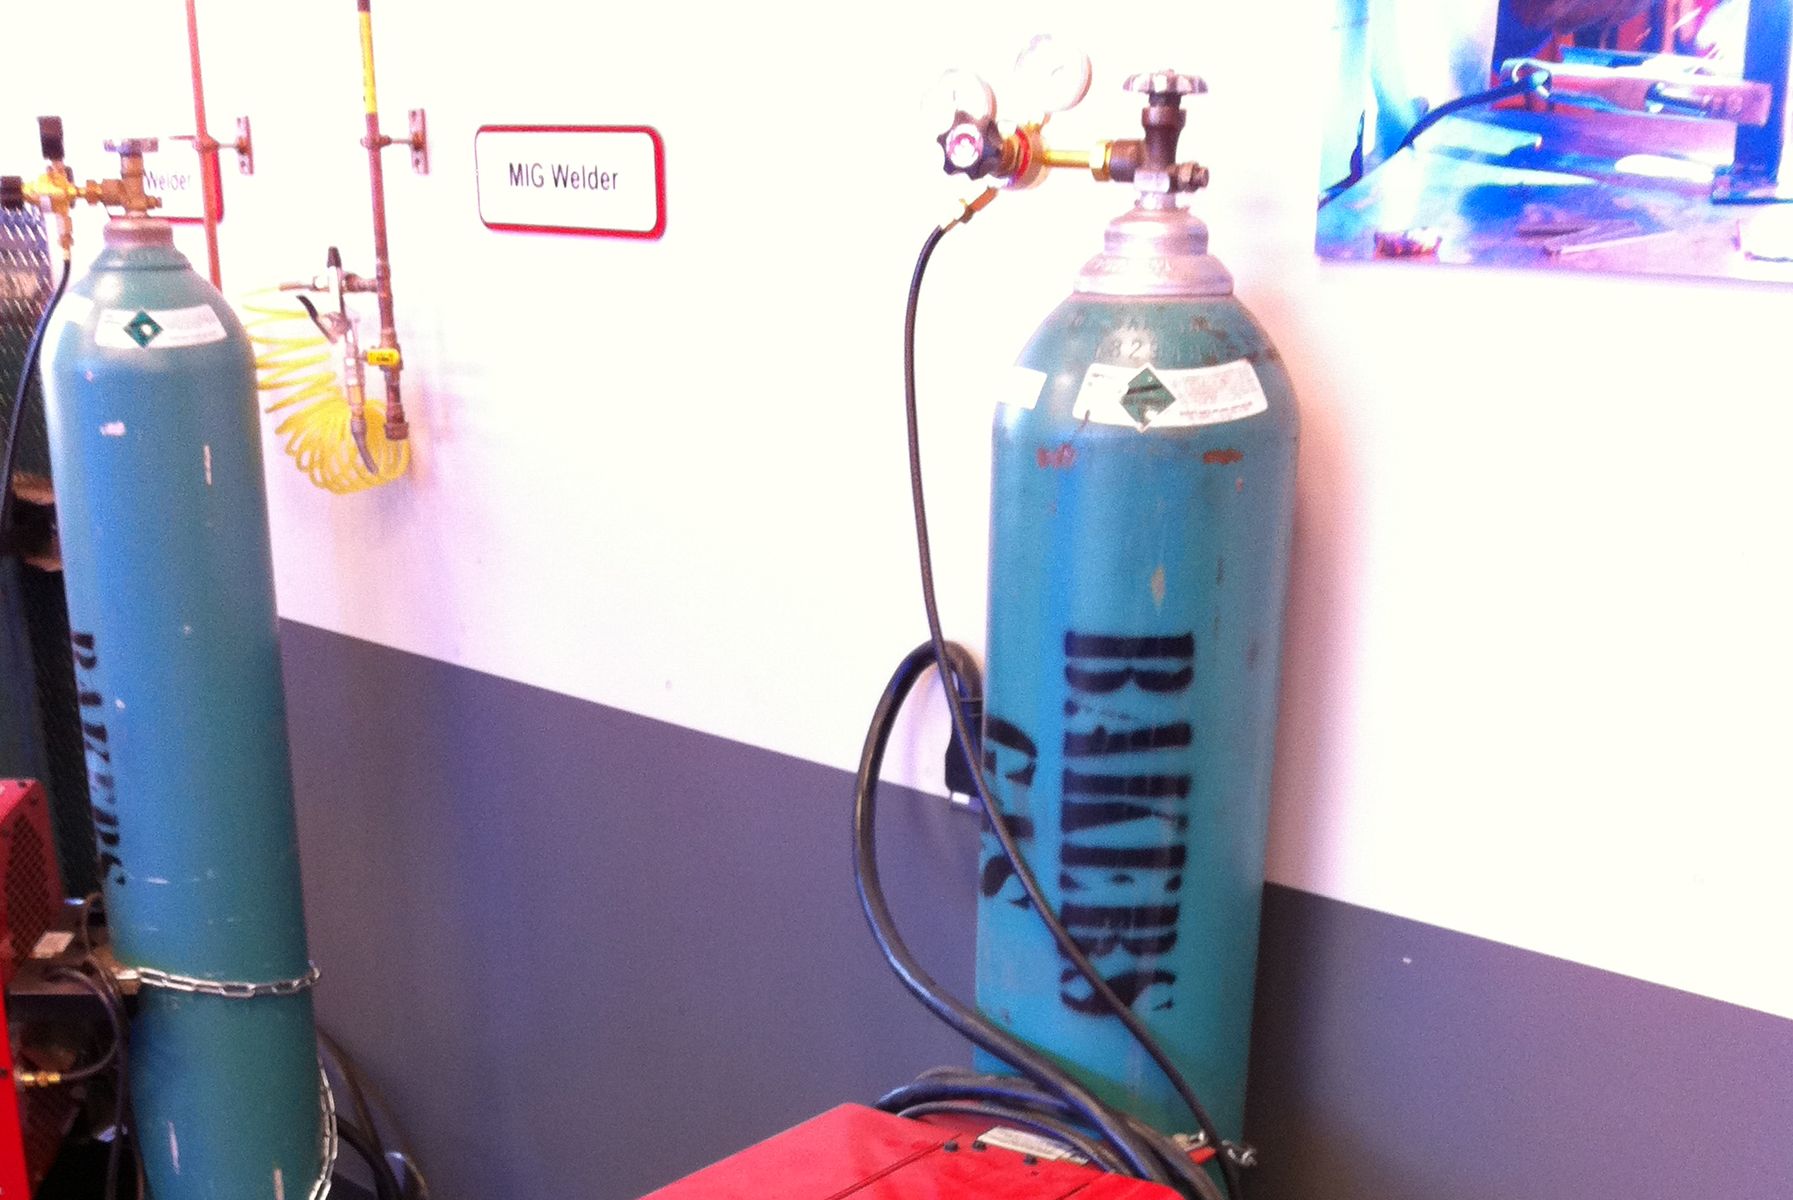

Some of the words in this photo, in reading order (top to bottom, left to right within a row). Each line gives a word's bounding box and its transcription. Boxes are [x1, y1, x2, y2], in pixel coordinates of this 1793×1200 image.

[508, 162, 545, 188] MIG
[551, 163, 618, 190] Welder
[1057, 631, 1195, 1017] BAKERS
